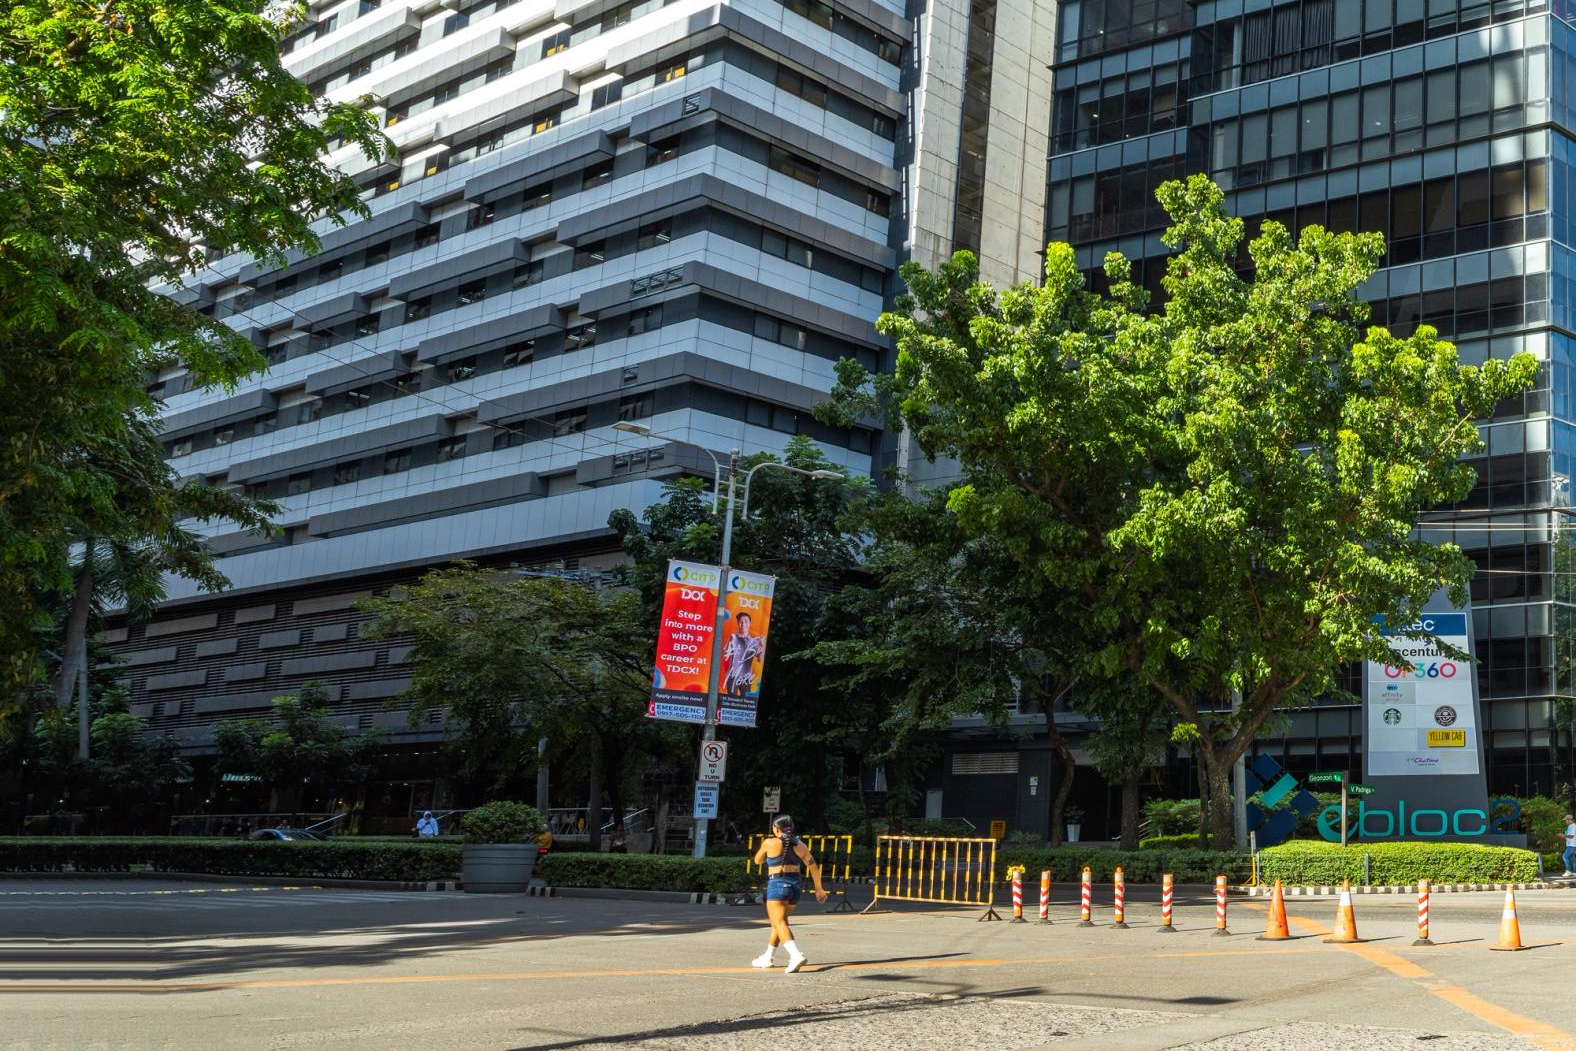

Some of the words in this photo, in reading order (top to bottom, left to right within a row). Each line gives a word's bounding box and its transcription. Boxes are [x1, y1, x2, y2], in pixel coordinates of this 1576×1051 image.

[678, 610, 702, 621] Step
[664, 618, 683, 629] into
[685, 622, 714, 633] more
[671, 632, 694, 642] with
[673, 643, 698, 653] BPO
[660, 653, 695, 663] career
[696, 656, 707, 665] at
[665, 664, 699, 675] TDCX!
[655, 692, 671, 701] Apply
[656, 704, 706, 715] EMERGENCY
[721, 709, 756, 719] EMERGENCY
[1429, 730, 1451, 741] YELLOW
[1451, 730, 1462, 741] CAB
